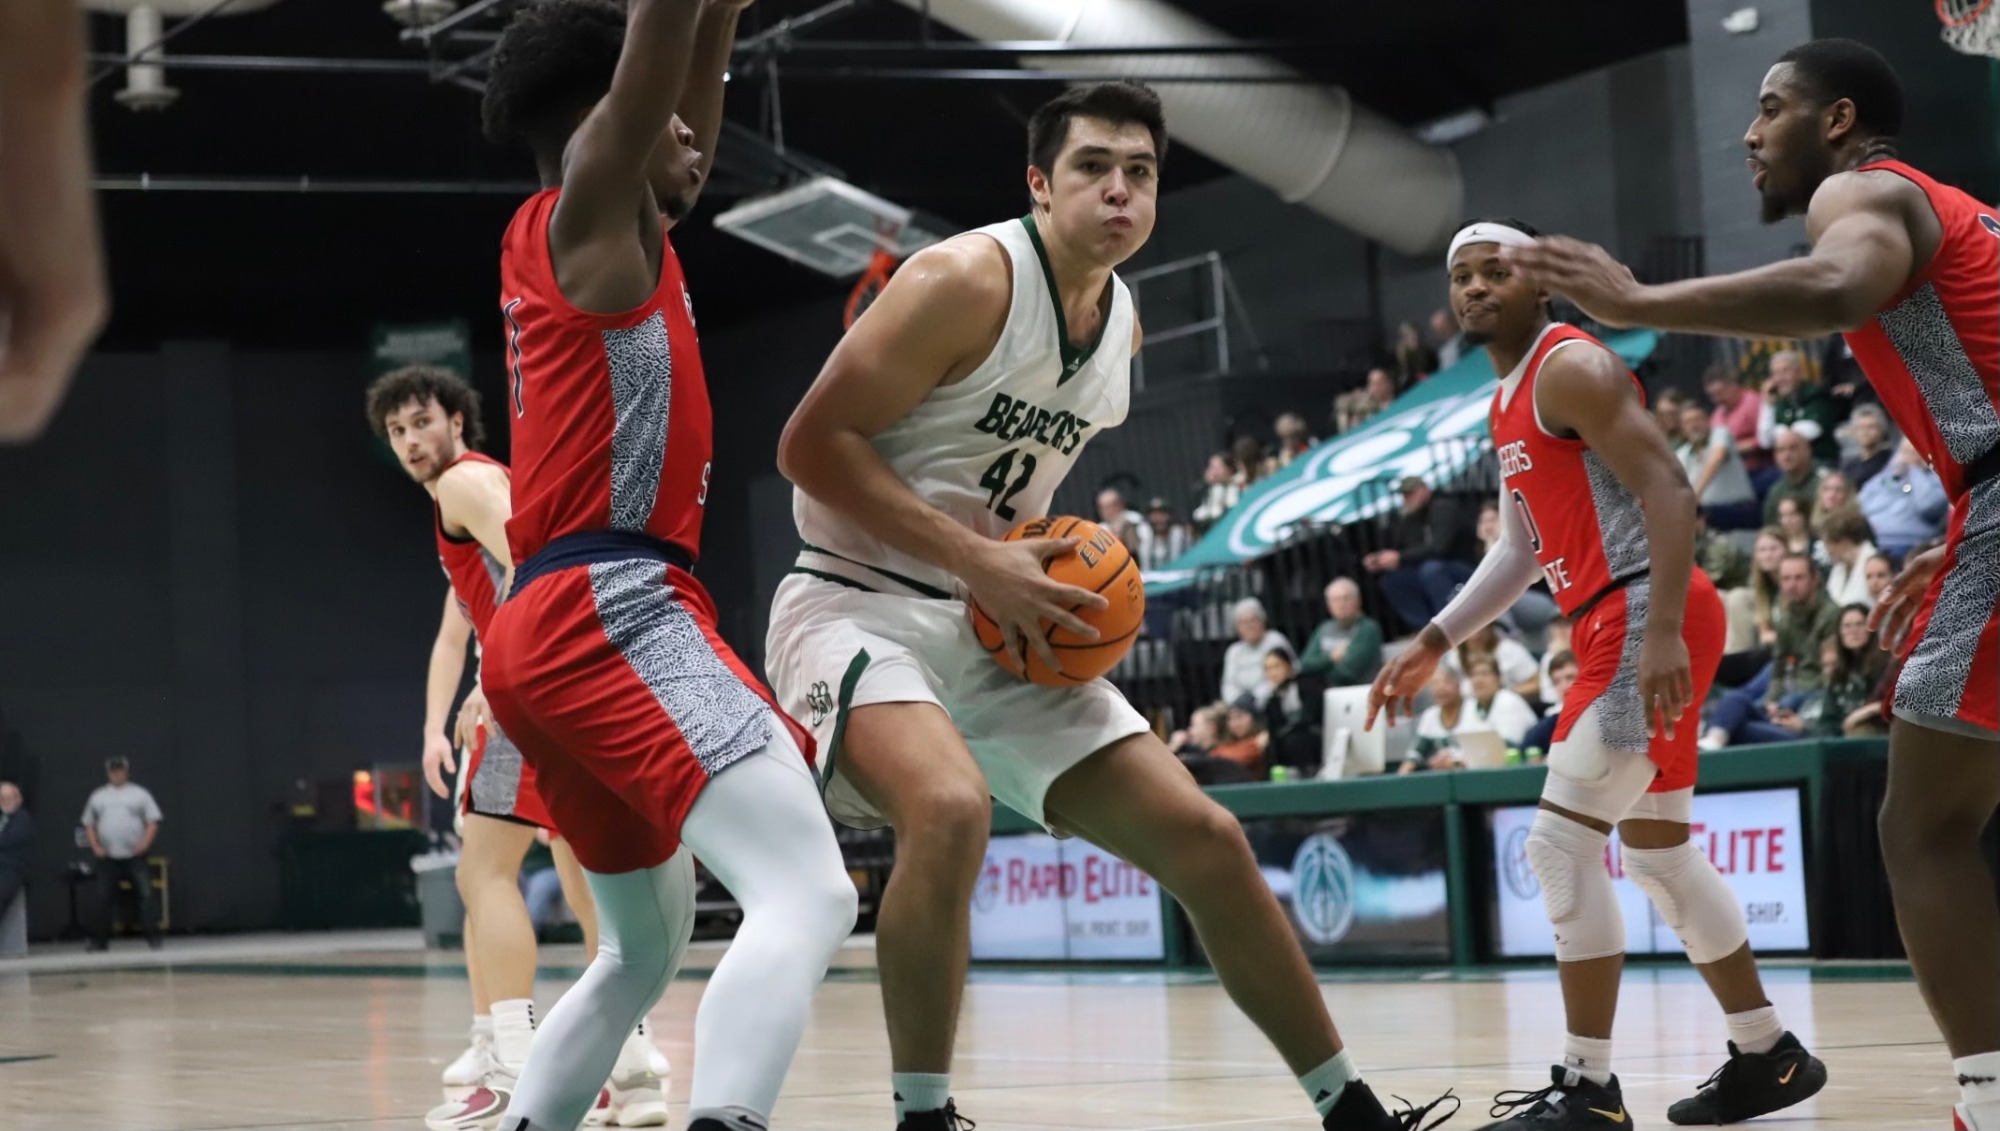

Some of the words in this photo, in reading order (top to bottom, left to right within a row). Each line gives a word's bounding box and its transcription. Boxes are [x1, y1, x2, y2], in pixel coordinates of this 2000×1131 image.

[979, 447, 1037, 522] 42
[1690, 823, 1786, 875] LITE
[1007, 857, 1078, 906] RAPID
[1083, 855, 1151, 904] ELITE
